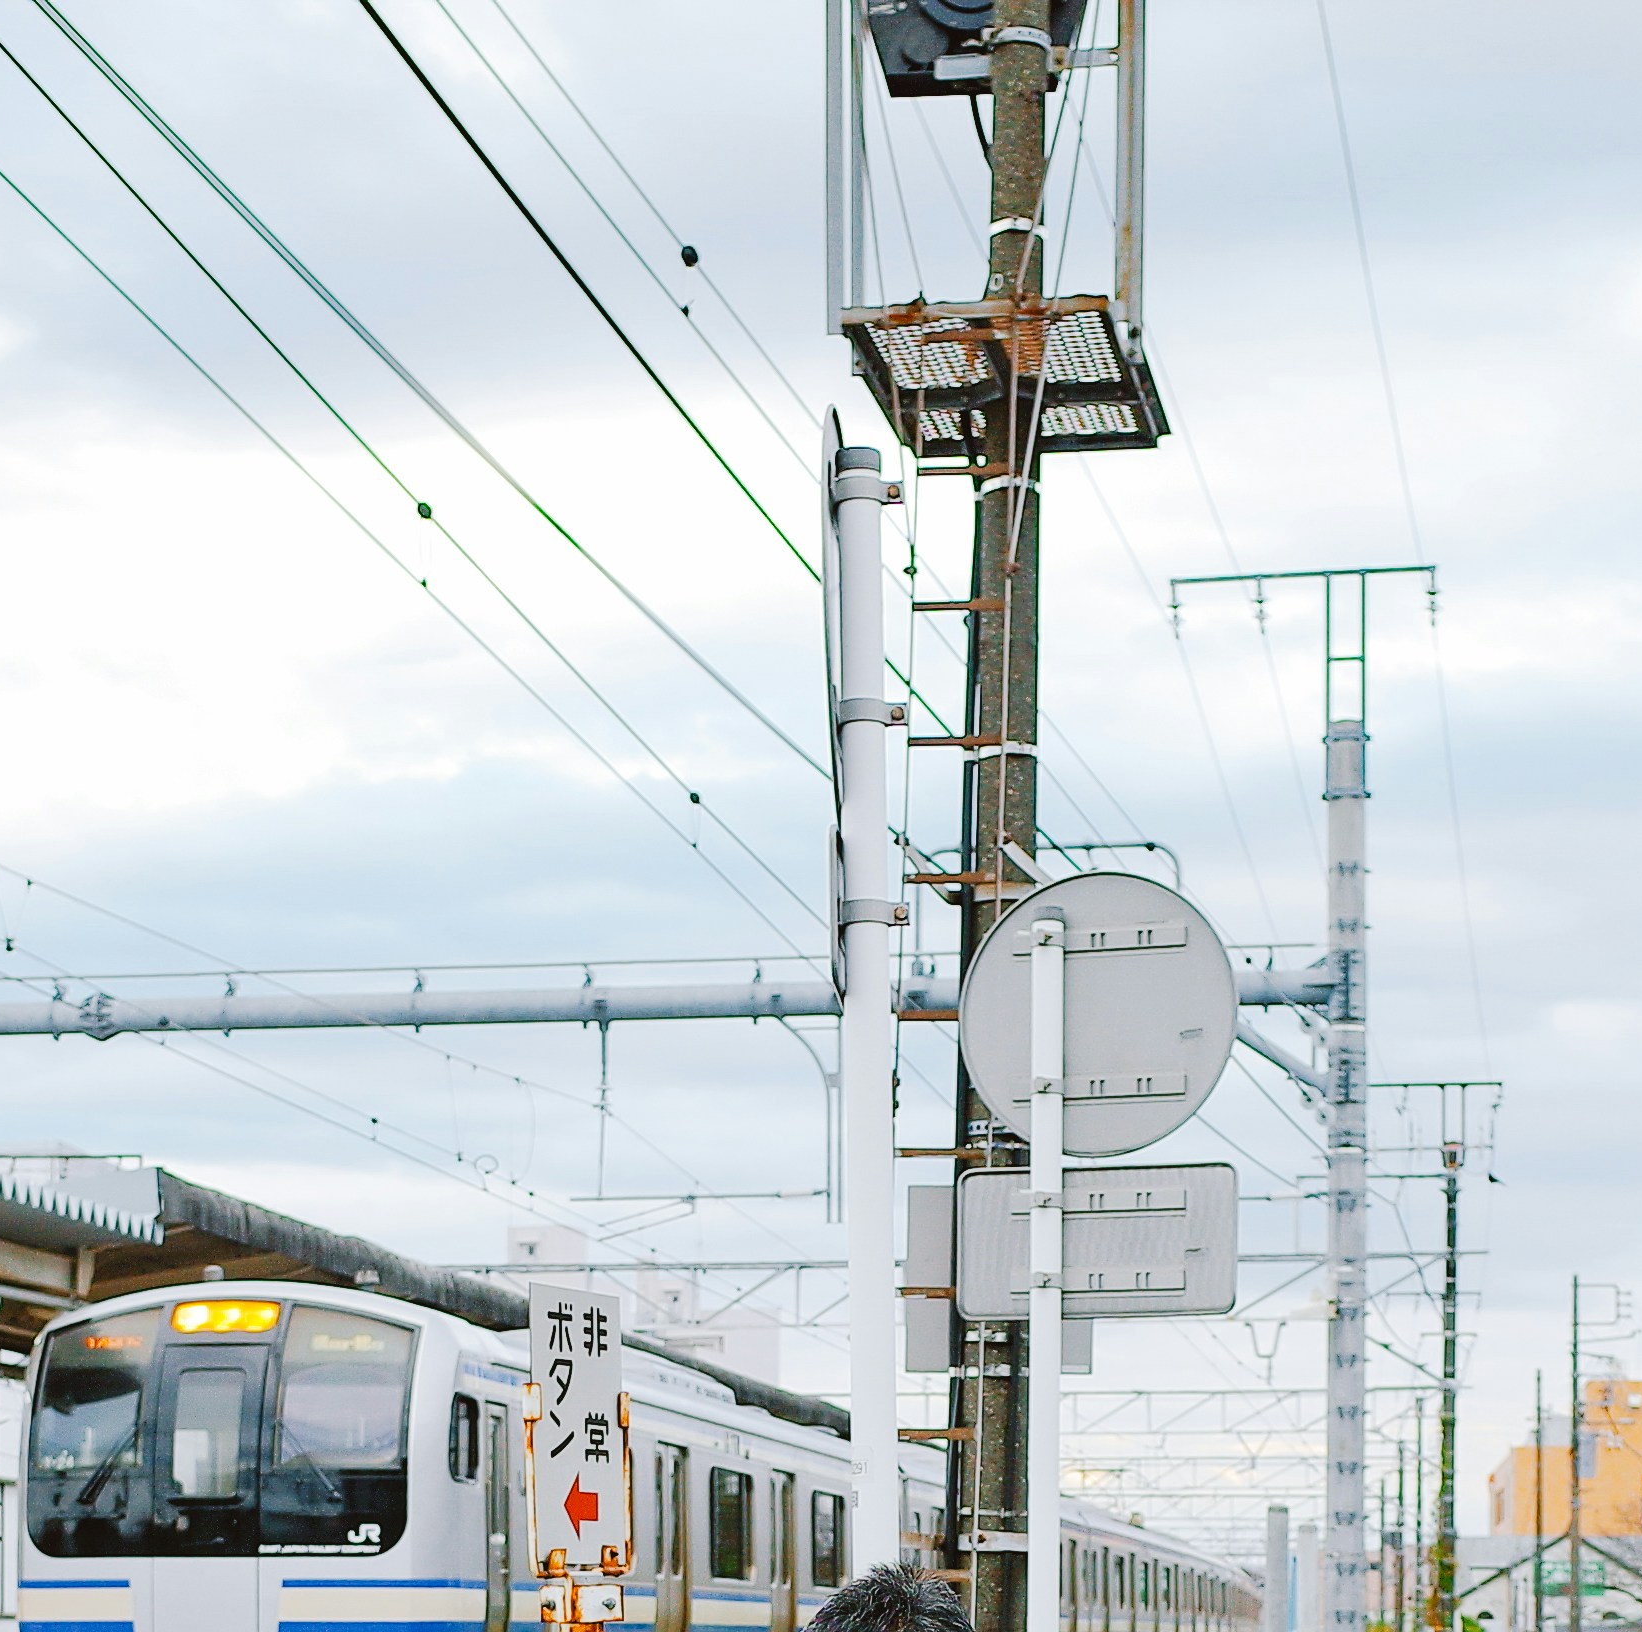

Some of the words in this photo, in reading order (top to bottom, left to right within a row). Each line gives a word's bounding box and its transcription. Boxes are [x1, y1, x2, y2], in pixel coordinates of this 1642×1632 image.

[547, 1302, 575, 1459] ボタン
[347, 1523, 382, 1544] JR
